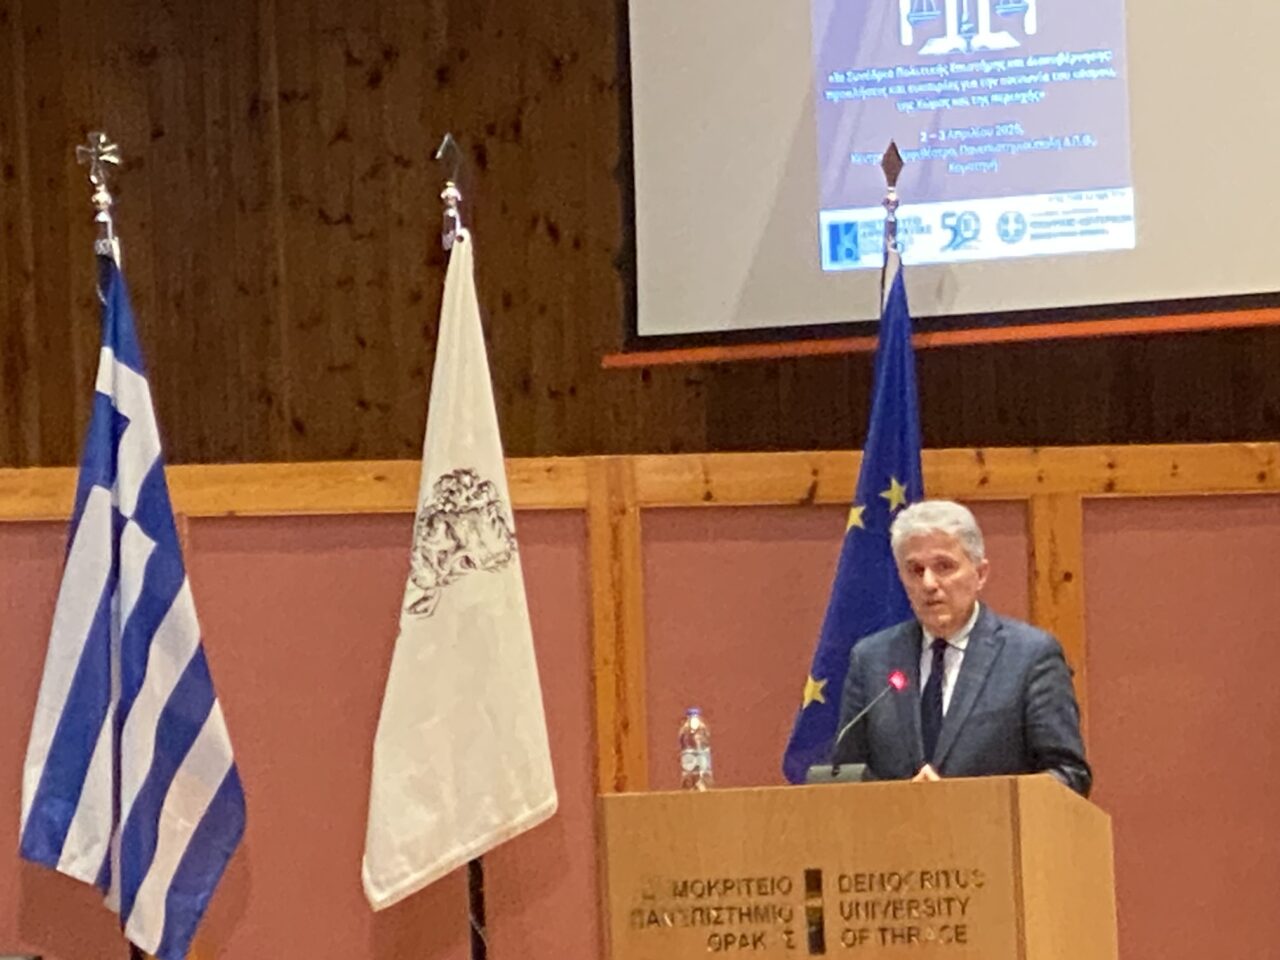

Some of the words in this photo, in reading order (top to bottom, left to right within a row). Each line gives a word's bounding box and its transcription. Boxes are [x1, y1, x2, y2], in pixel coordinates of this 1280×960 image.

[920, 131, 927, 142] 2
[938, 129, 945, 141] 3
[946, 127, 994, 141] Απριλίου
[642, 876, 793, 900] ΜΟΚΡΙΤΕΙΟ
[839, 896, 970, 921] UNIVERSITY
[707, 930, 795, 952] ΘΡΑΚΣ
[841, 927, 870, 948] OF
